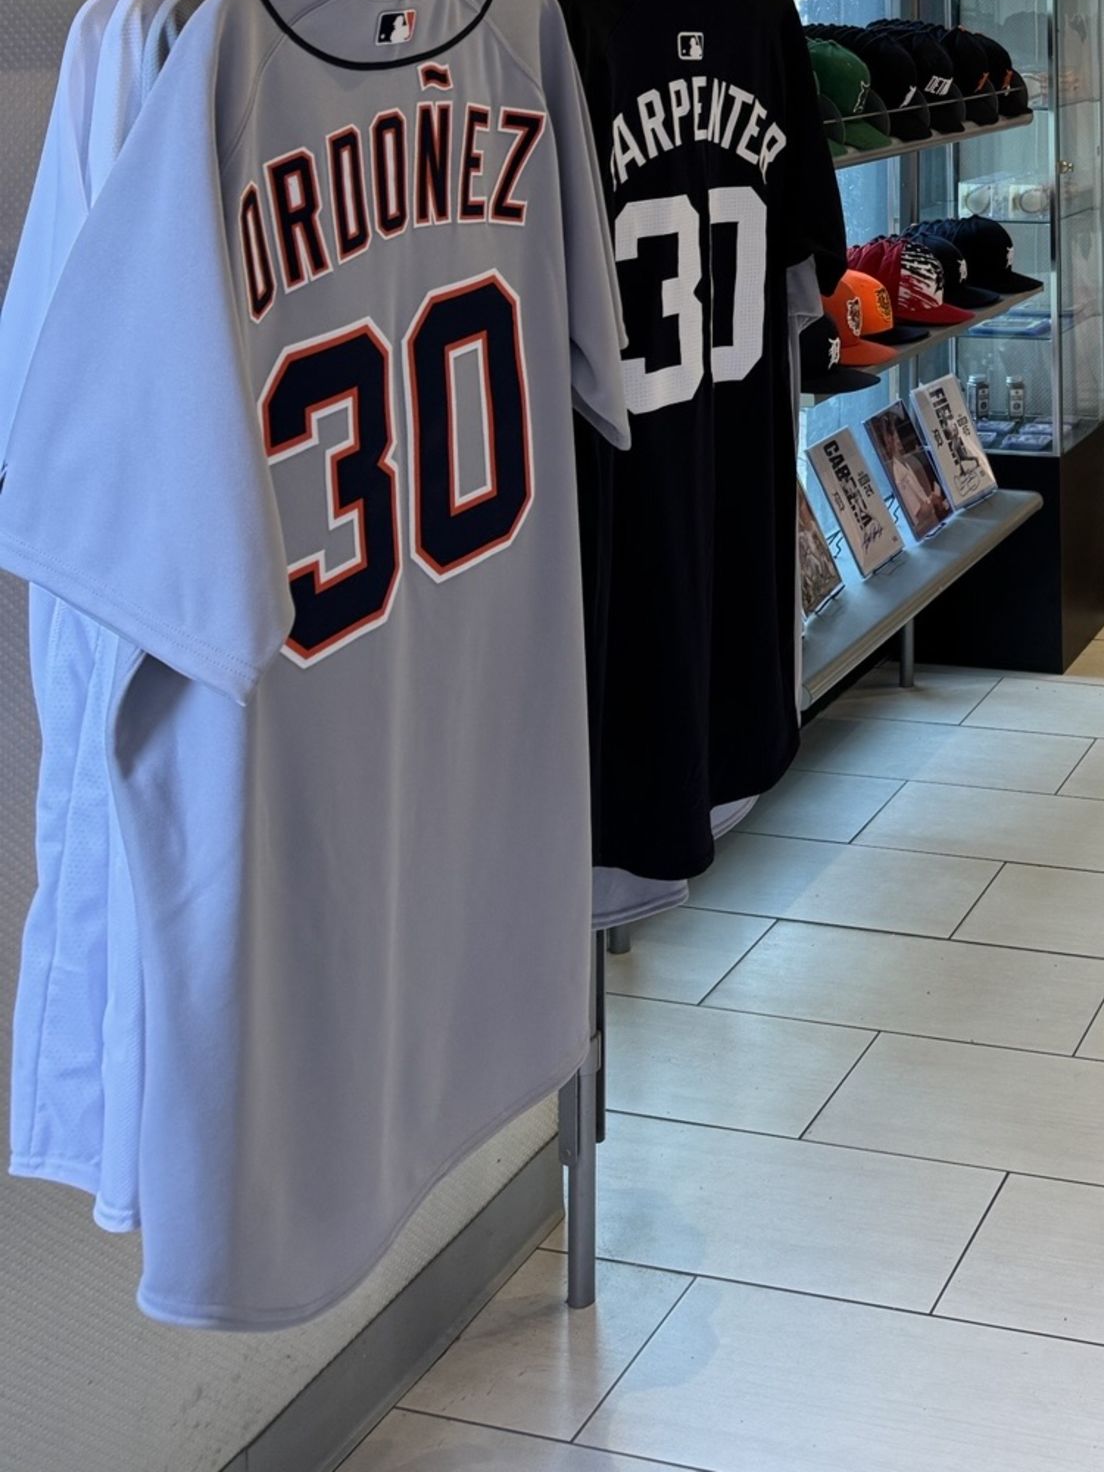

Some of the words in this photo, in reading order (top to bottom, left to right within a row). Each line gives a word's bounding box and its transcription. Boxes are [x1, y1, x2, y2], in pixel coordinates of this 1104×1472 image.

[239, 62, 547, 323] ORDOÑEZ
[610, 76, 787, 192] ARPENTER
[615, 186, 767, 415] 30
[258, 268, 535, 668] 30
